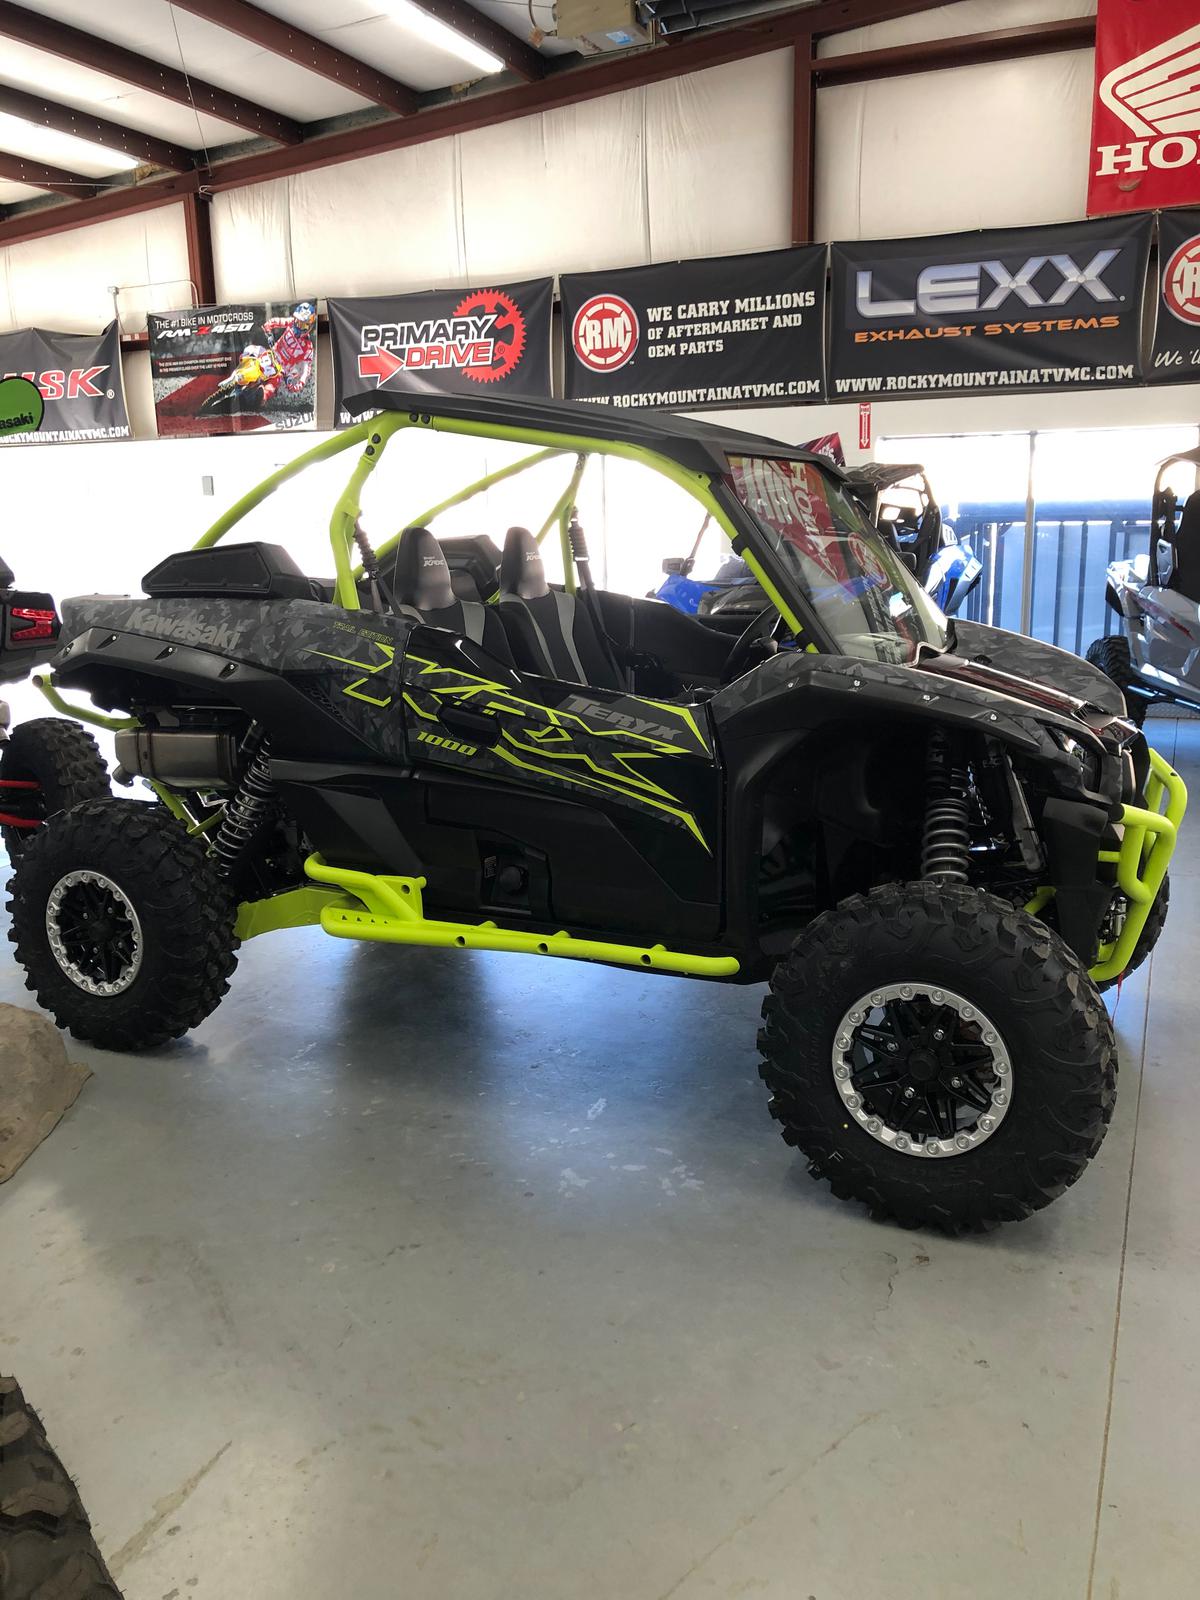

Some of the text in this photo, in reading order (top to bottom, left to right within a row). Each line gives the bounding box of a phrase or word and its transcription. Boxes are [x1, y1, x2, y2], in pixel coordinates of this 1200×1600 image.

[1096, 136, 1200, 176] HO
[855, 248, 1122, 319] LEXX
[155, 320, 169, 329] THE
[181, 317, 196, 327] BIKE
[197, 316, 206, 325] IN
[206, 312, 254, 324] MOTOCROSS
[647, 291, 815, 322] WE CARRY MILLIONS
[361, 314, 498, 351] PRIMARY
[586, 317, 625, 350] RM
[647, 313, 802, 340] OF AFTERMARKET AND
[854, 315, 1120, 343] EXHAUST SYSTEMS
[403, 338, 495, 371] DRIVE
[647, 339, 724, 358] OEM PARTS
[1154, 350, 1183, 368] We
[3, 365, 110, 400] SK
[835, 364, 1134, 392] WWW.ROCKYMOUNTAINATVMC.COM
[124, 606, 241, 650] Kawasaki
[567, 694, 683, 740] TERYX
[417, 731, 478, 756] 1000
